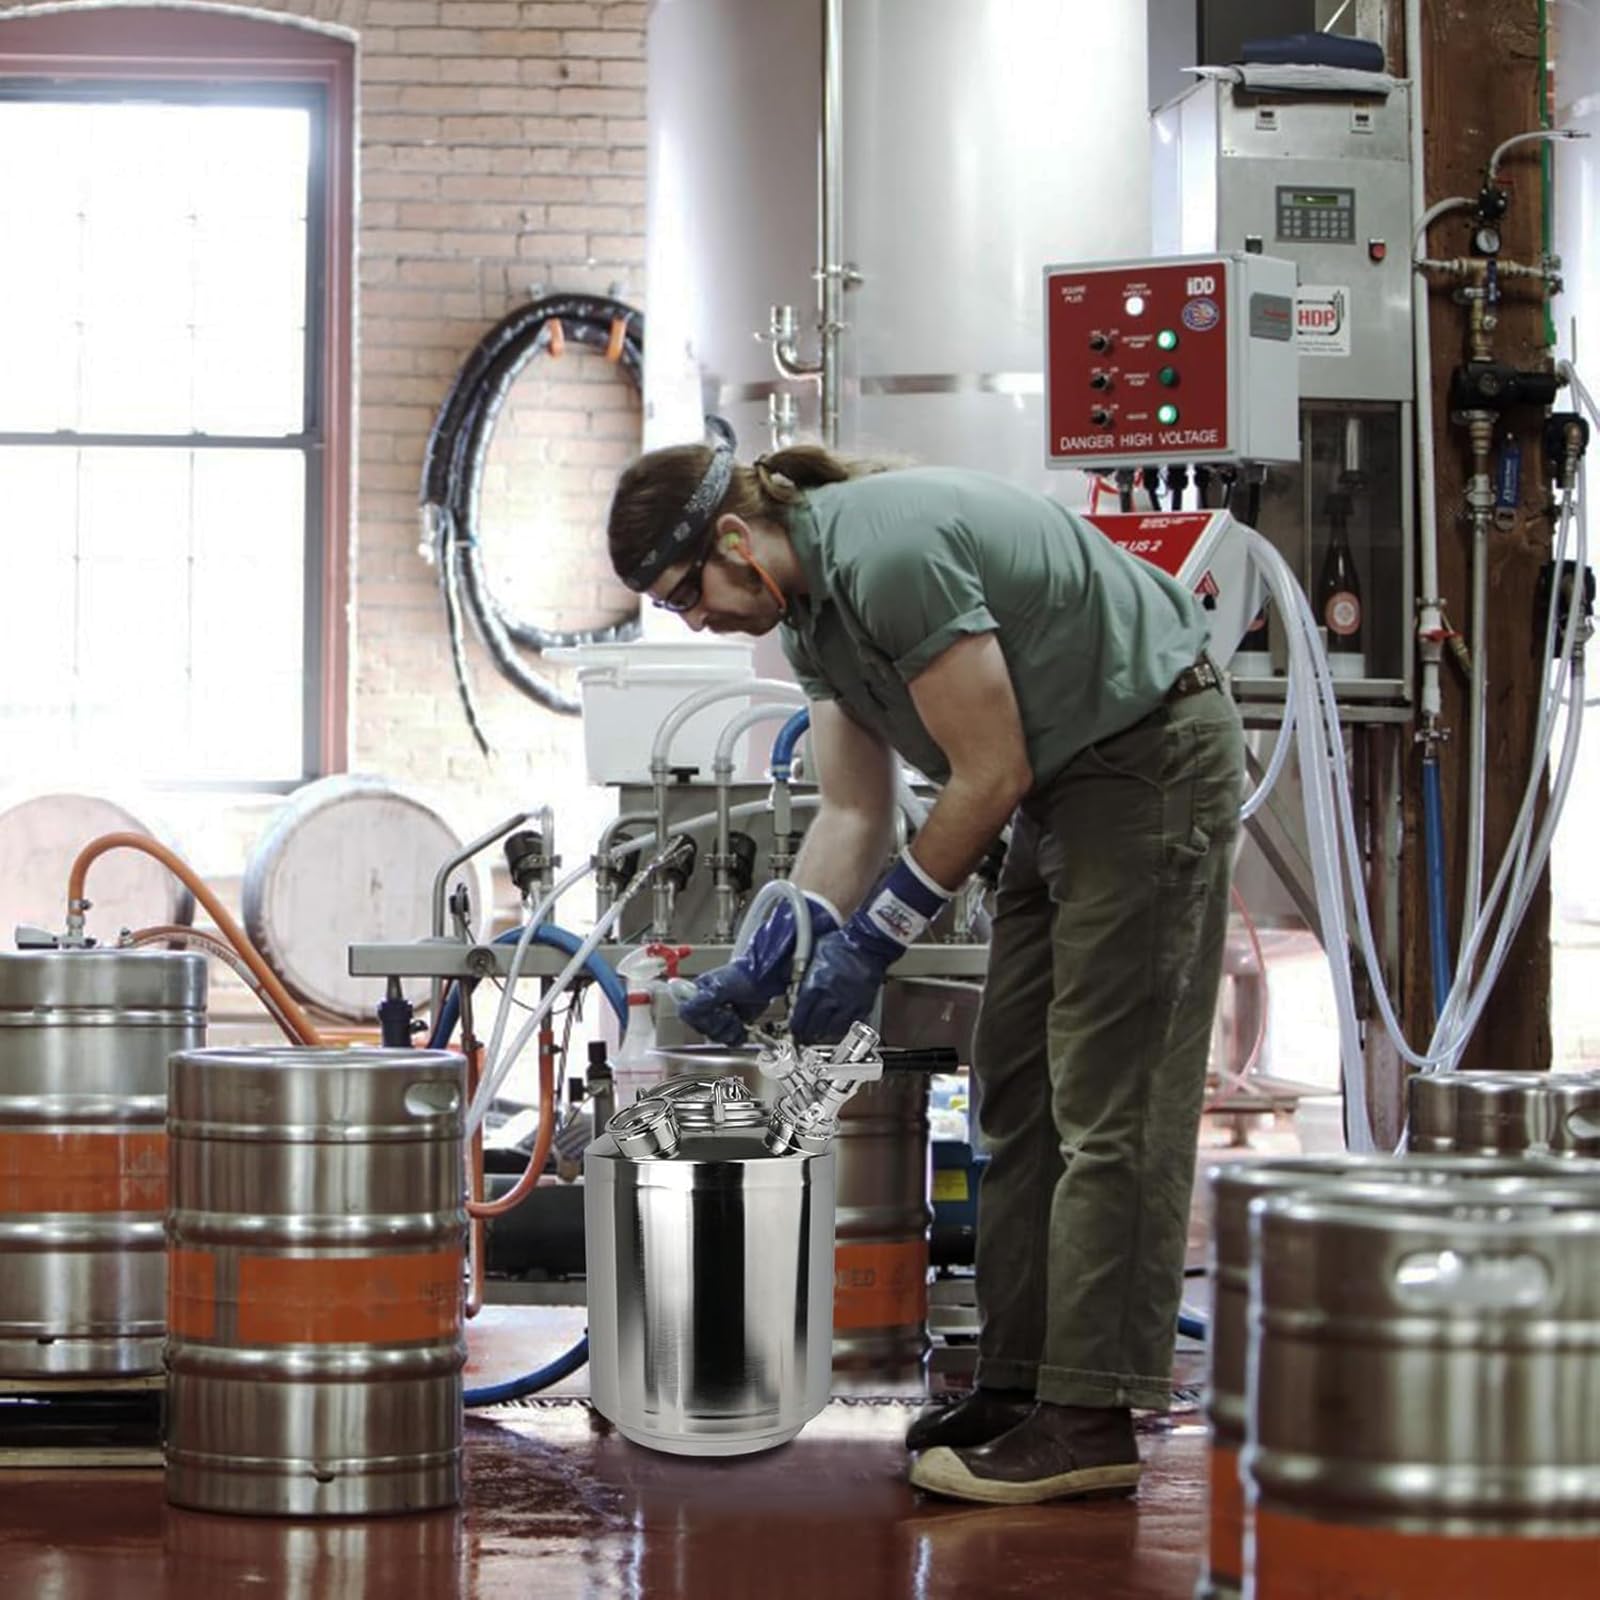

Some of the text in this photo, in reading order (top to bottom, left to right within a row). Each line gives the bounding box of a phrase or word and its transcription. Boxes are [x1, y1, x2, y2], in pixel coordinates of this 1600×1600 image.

[1187, 275, 1216, 296] IDD
[1060, 428, 1219, 450] DANGER HIGH VOLTAGE
